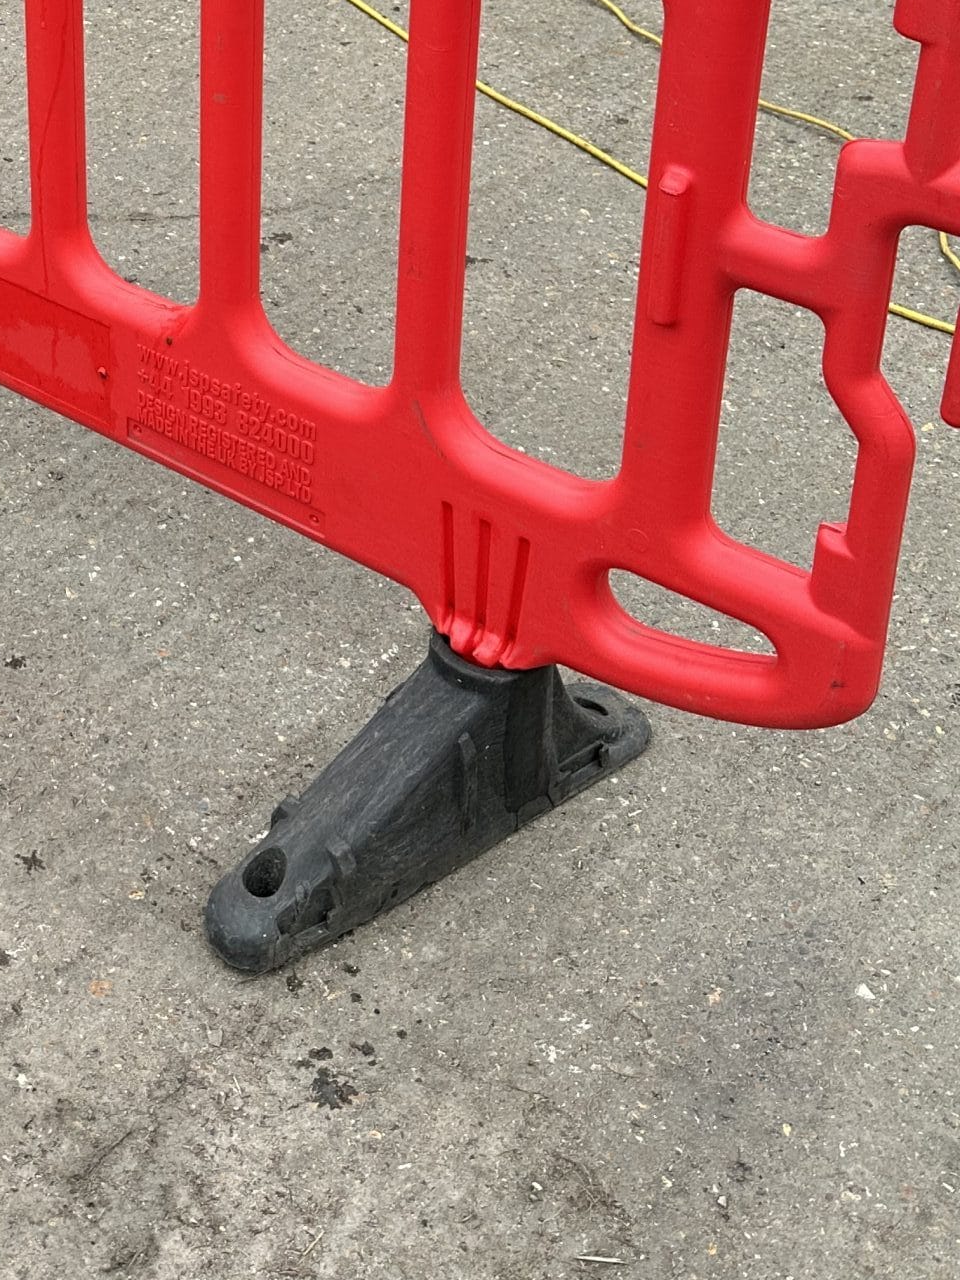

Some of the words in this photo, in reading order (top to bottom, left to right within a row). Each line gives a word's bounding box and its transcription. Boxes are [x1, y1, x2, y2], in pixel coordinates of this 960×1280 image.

[137, 343, 318, 442] www.jspsafety.com
[137, 390, 188, 426] DESIGN
[190, 414, 276, 469] REGISTERED
[281, 459, 312, 486] AND
[181, 386, 228, 424] 1993
[238, 410, 315, 465] 824000
[137, 406, 173, 437] MADE
[176, 426, 189, 448] IN
[191, 431, 217, 458] THE
[219, 444, 235, 468] UK
[240, 458, 257, 479] BY
[259, 463, 284, 490] JSP
[287, 479, 312, 505] LTD
